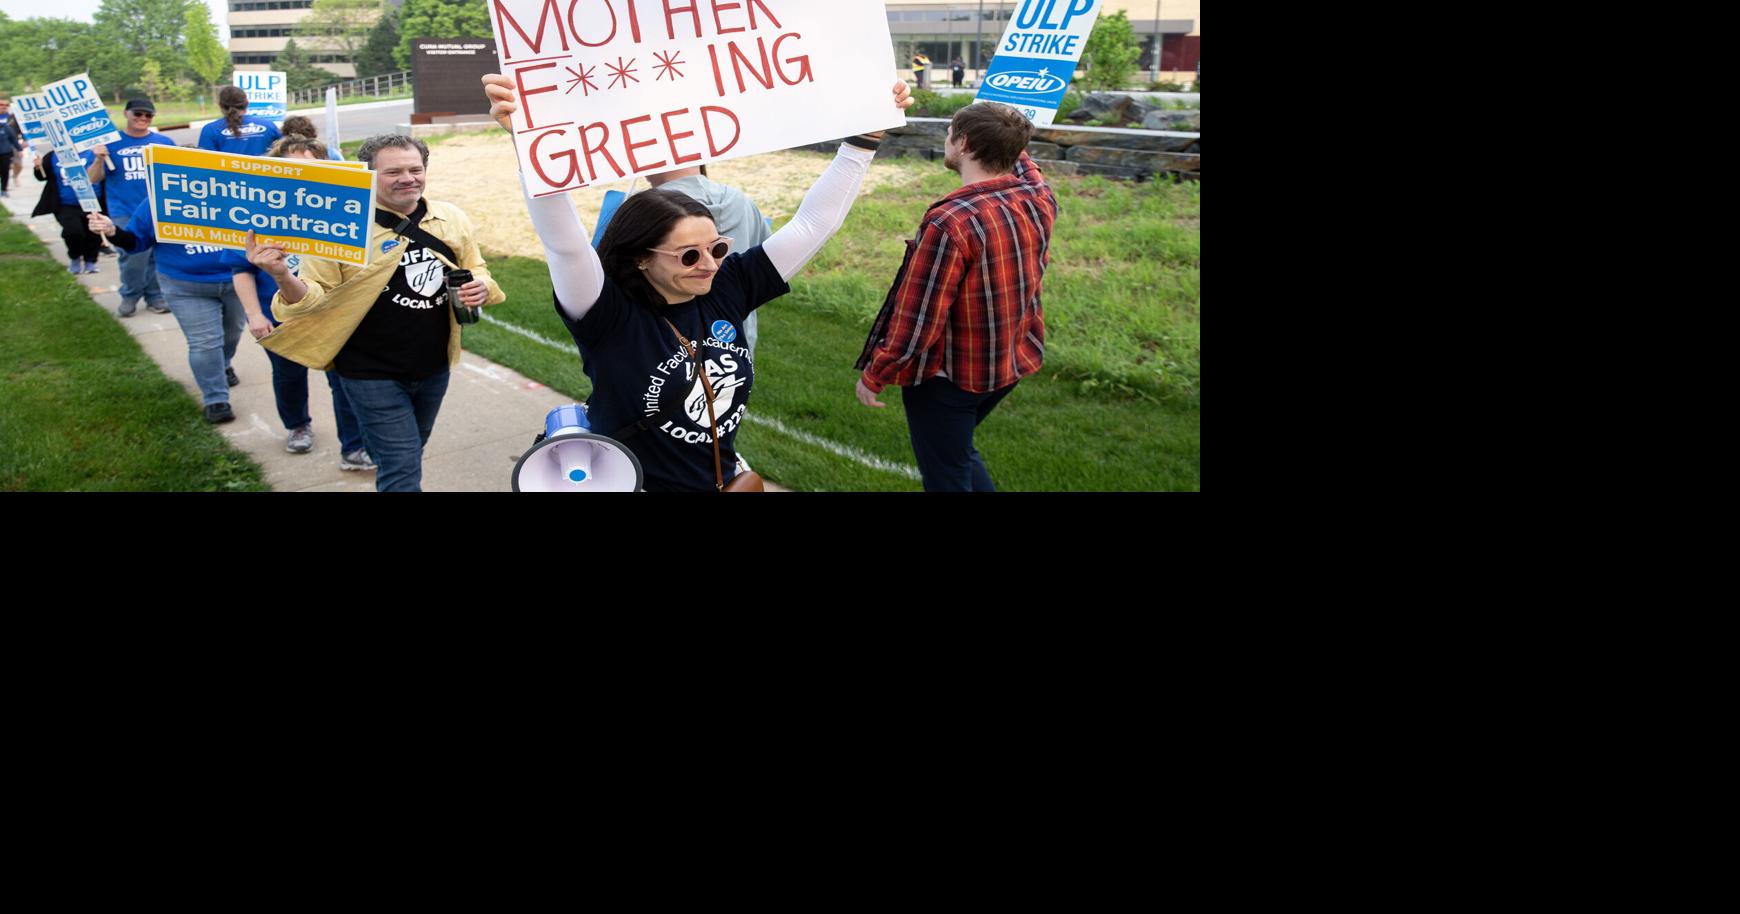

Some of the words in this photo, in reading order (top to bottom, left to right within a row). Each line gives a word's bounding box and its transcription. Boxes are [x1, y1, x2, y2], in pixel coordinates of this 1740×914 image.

[1016, 0, 1094, 30] ULP
[1004, 33, 1079, 55] STRIKE
[48, 79, 87, 106] ULP
[239, 75, 281, 90] ULP
[992, 75, 1055, 91] OPEIU
[529, 105, 741, 188] GREED
[123, 157, 145, 172] UL
[220, 159, 226, 168] I
[231, 160, 303, 176] SUPPORT
[124, 171, 146, 181] STR
[161, 172, 287, 209] Fighting
[294, 188, 337, 210] for
[343, 203, 362, 215] a
[164, 198, 221, 221] Fair
[229, 207, 359, 240] Contract
[162, 225, 205, 239] CUNA
[209, 229, 259, 246] Mutul
[314, 244, 362, 261] United
[399, 247, 436, 266] UFA
[392, 293, 433, 309] LOCAL
[685, 353, 738, 381] UAS
[660, 420, 713, 443] LOCAL
